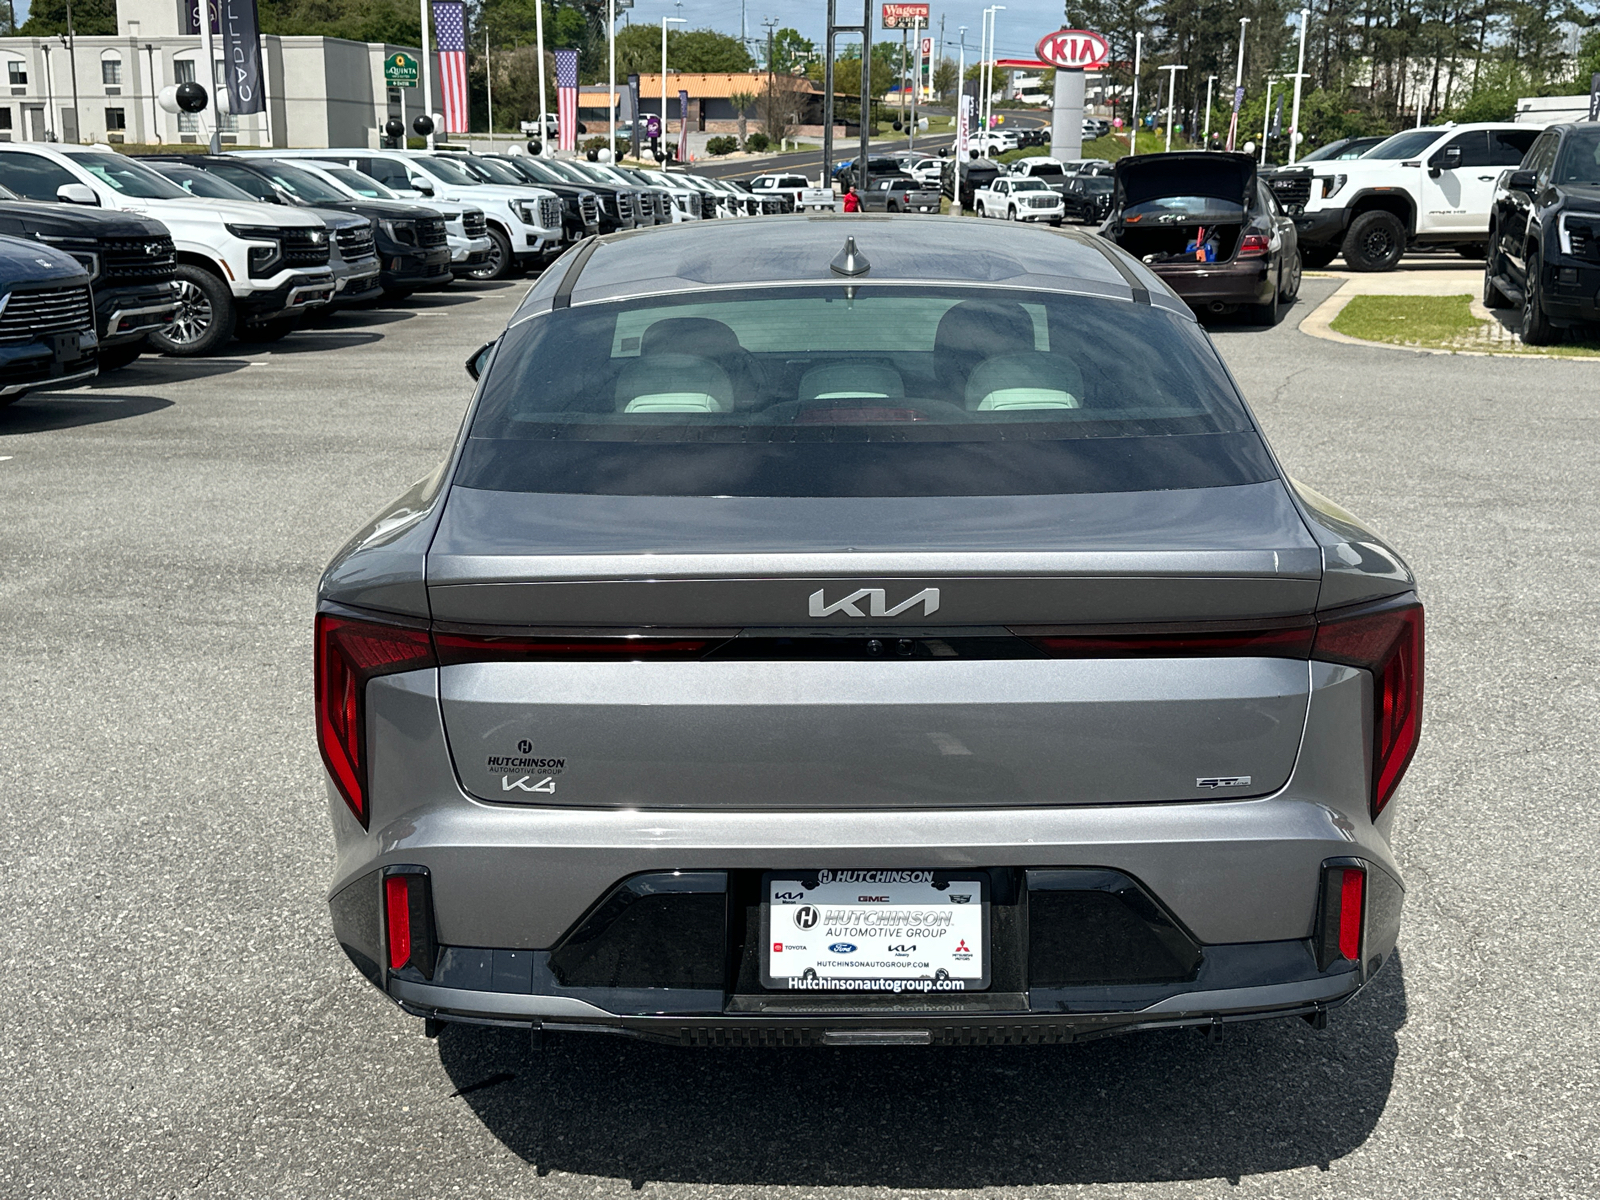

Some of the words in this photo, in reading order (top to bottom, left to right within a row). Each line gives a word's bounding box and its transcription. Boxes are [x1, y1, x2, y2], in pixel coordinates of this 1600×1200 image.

[884, 5, 927, 17] Wagers
[227, 0, 252, 102] CADILL
[1051, 38, 1096, 61] KIA
[390, 67, 416, 76] QUINTA
[809, 588, 940, 617] KIA
[488, 756, 565, 768] HUTCHINSON
[489, 766, 535, 774] AUTOMOTIVE
[502, 775, 556, 795] K4
[836, 870, 933, 883] HUTCHINSON
[775, 892, 804, 900] KIA
[858, 895, 890, 903] GMC
[823, 910, 953, 927] HUTCHINSON
[825, 928, 902, 938] AUTOMOTIVE
[906, 928, 947, 938] GROUP
[888, 944, 917, 952] KIA
[788, 977, 965, 993] Hutchinsonautogroup.com
